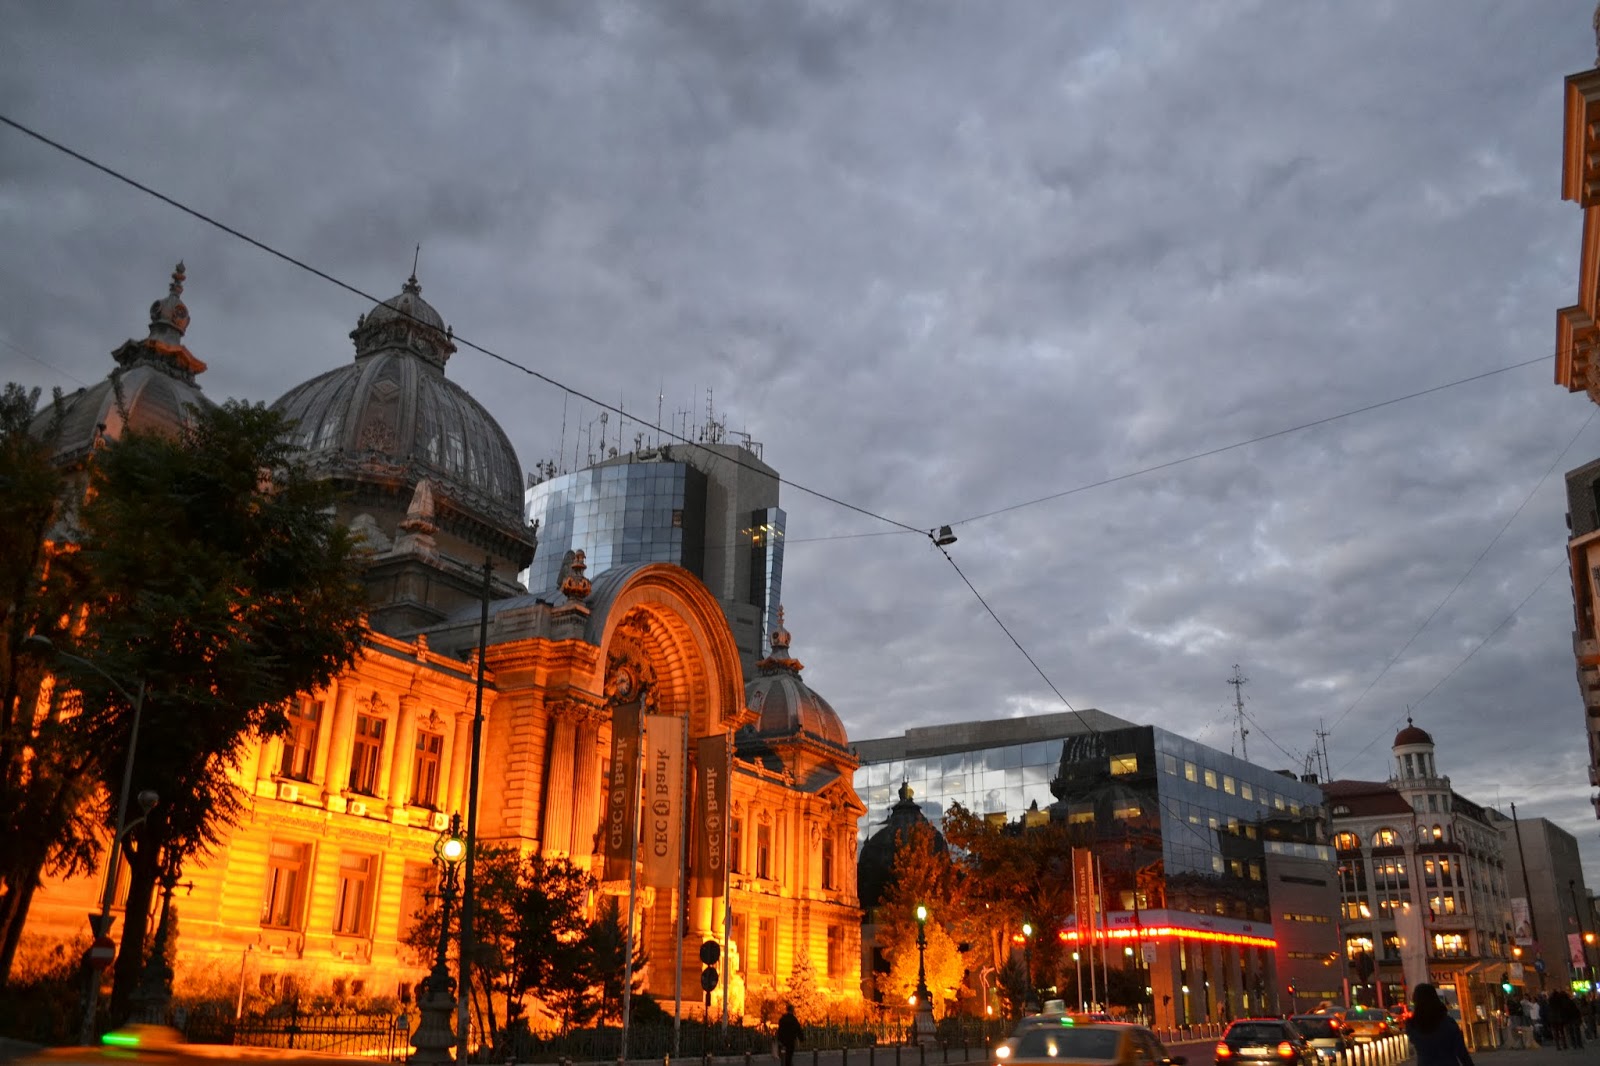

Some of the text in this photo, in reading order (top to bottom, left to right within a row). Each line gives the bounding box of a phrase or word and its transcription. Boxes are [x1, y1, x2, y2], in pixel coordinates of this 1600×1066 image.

[612, 737, 627, 849] CEC Bank
[655, 748, 670, 857] CEC Bank
[706, 766, 720, 870] CEC Bank
[1114, 916, 1130, 924] BCR
